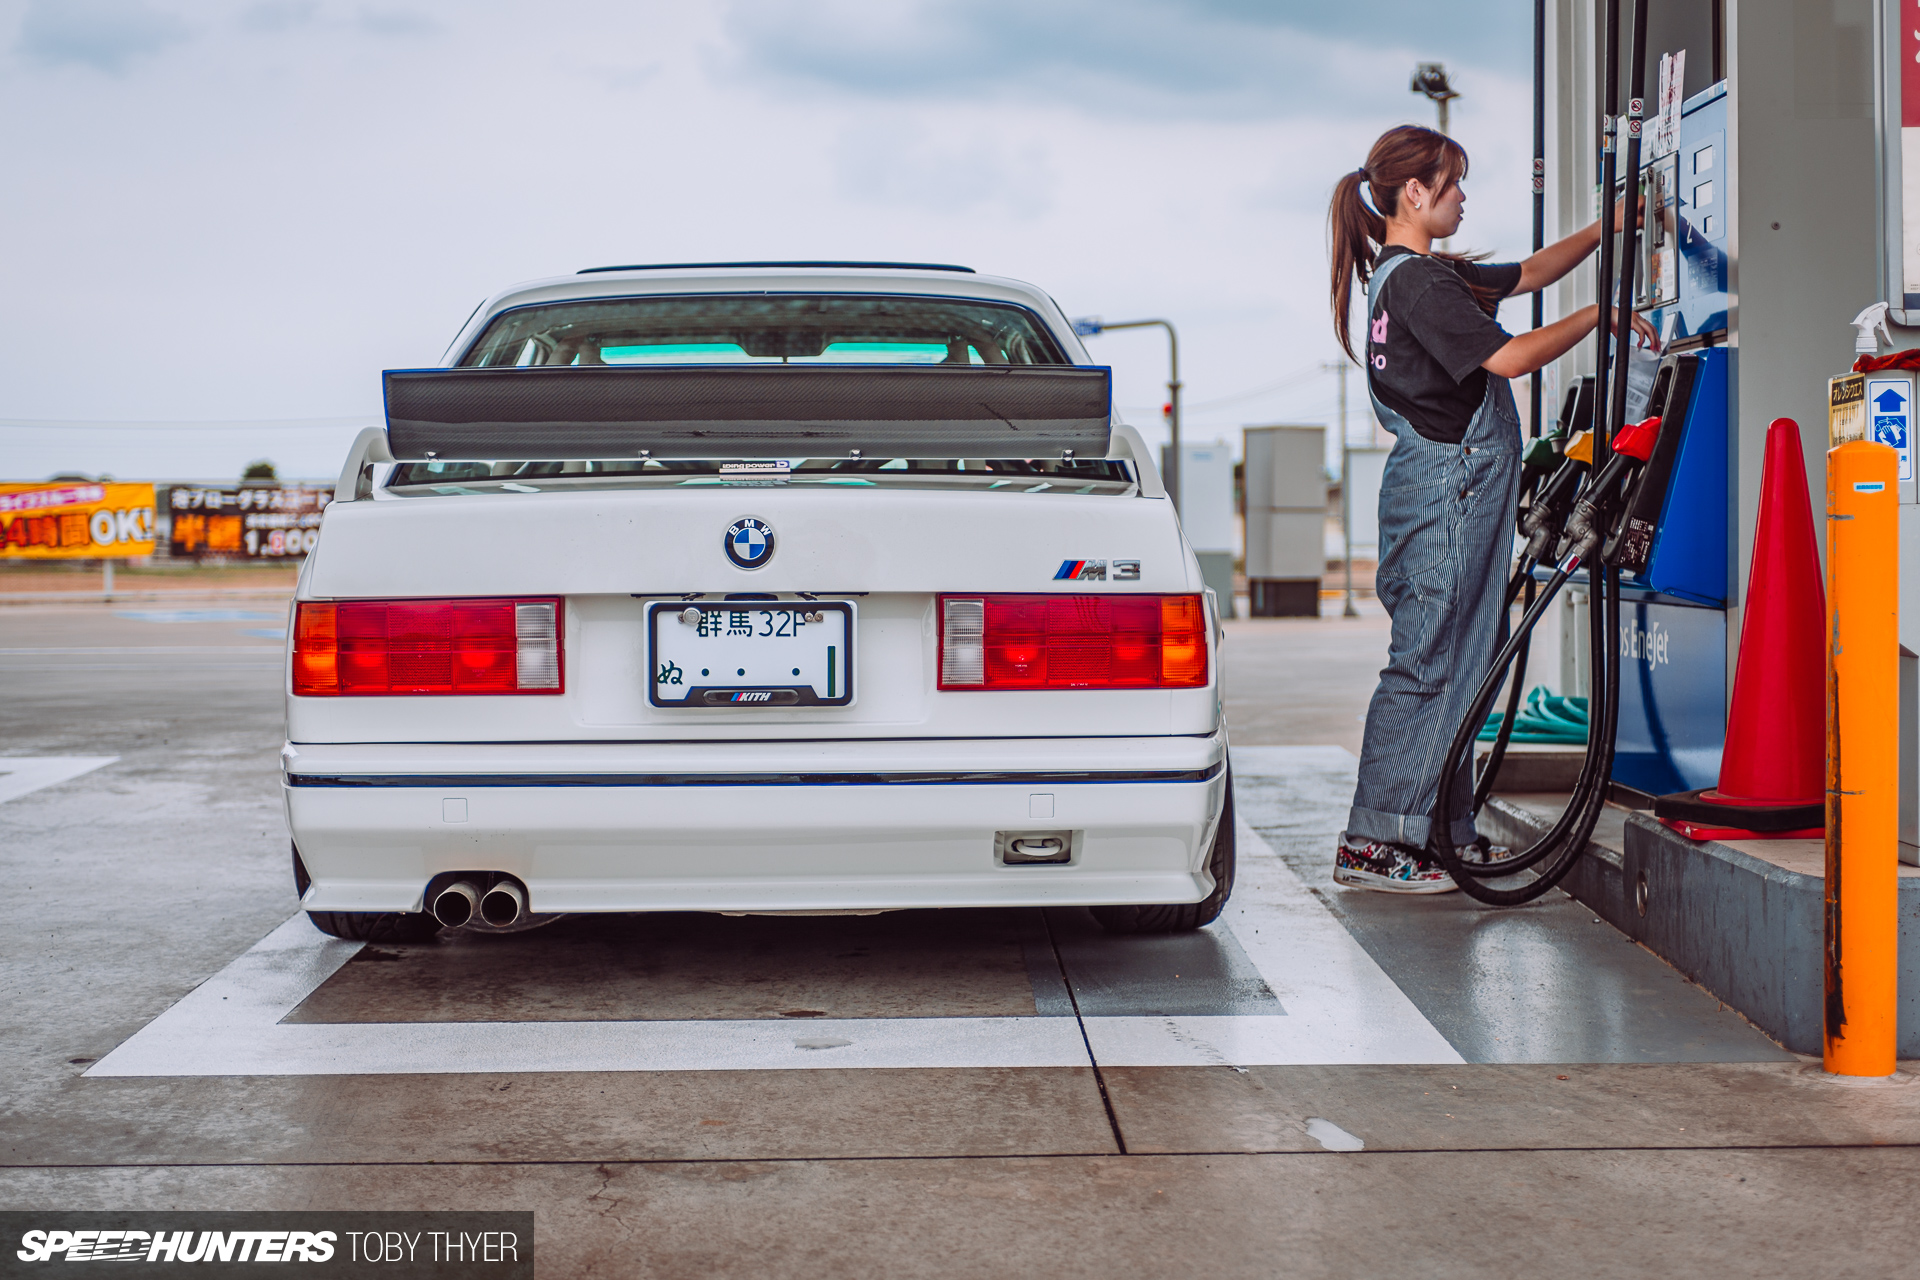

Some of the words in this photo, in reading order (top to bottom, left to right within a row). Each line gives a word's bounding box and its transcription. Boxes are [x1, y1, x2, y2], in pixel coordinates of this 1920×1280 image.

[729, 519, 771, 536] BMW
[1077, 559, 1140, 581] M3
[1631, 618, 1669, 671] Enejet
[657, 660, 683, 685] ぬ
[738, 692, 771, 702] KITH
